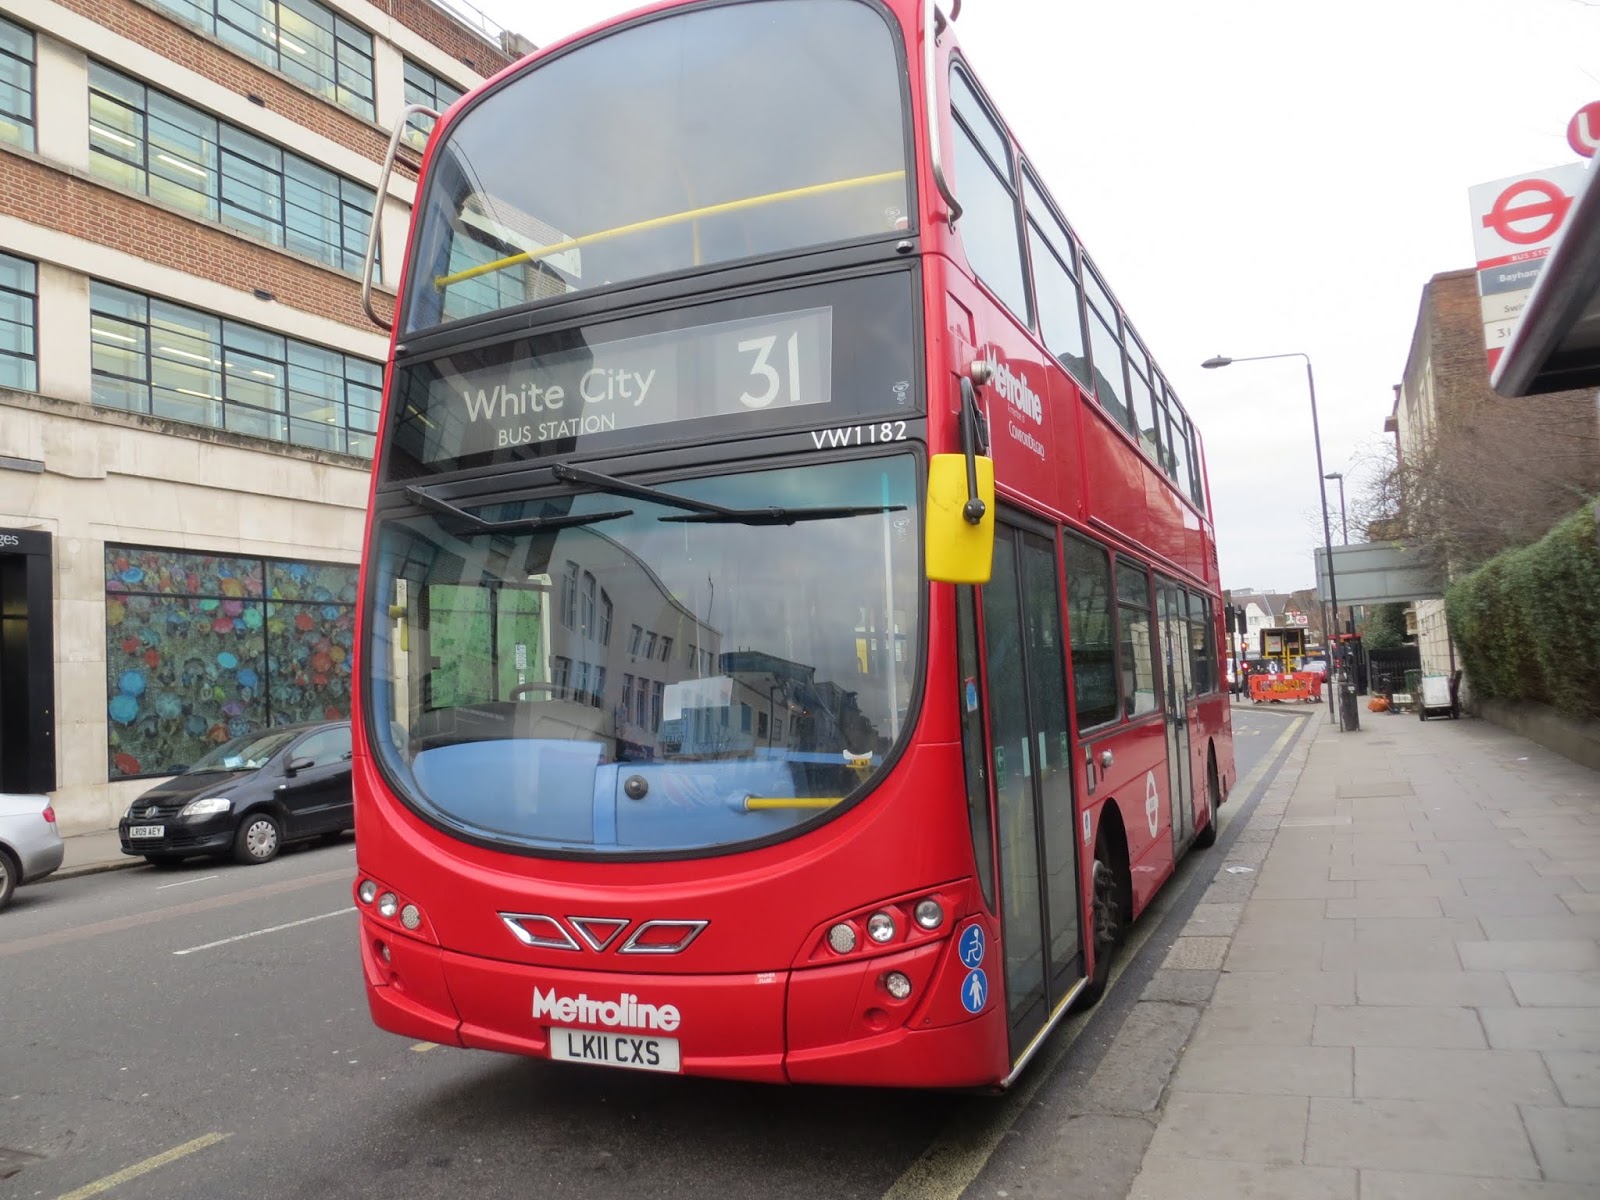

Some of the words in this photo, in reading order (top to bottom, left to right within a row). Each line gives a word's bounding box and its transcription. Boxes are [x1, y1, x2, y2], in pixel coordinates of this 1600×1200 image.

[1512, 252, 1528, 261] BUS
[1532, 248, 1552, 257] STO
[1500, 269, 1541, 283] Bayham
[738, 331, 800, 408] 31
[463, 383, 564, 422] White
[580, 367, 656, 406] City
[985, 347, 1042, 426] Metroline
[498, 424, 532, 447] BUS
[538, 413, 616, 442] STATION
[811, 420, 907, 450] VW1182
[148, 826, 161, 835] AEY
[532, 986, 680, 1031] Metroline
[568, 1033, 608, 1060] LK11
[615, 1038, 660, 1065] CXS
